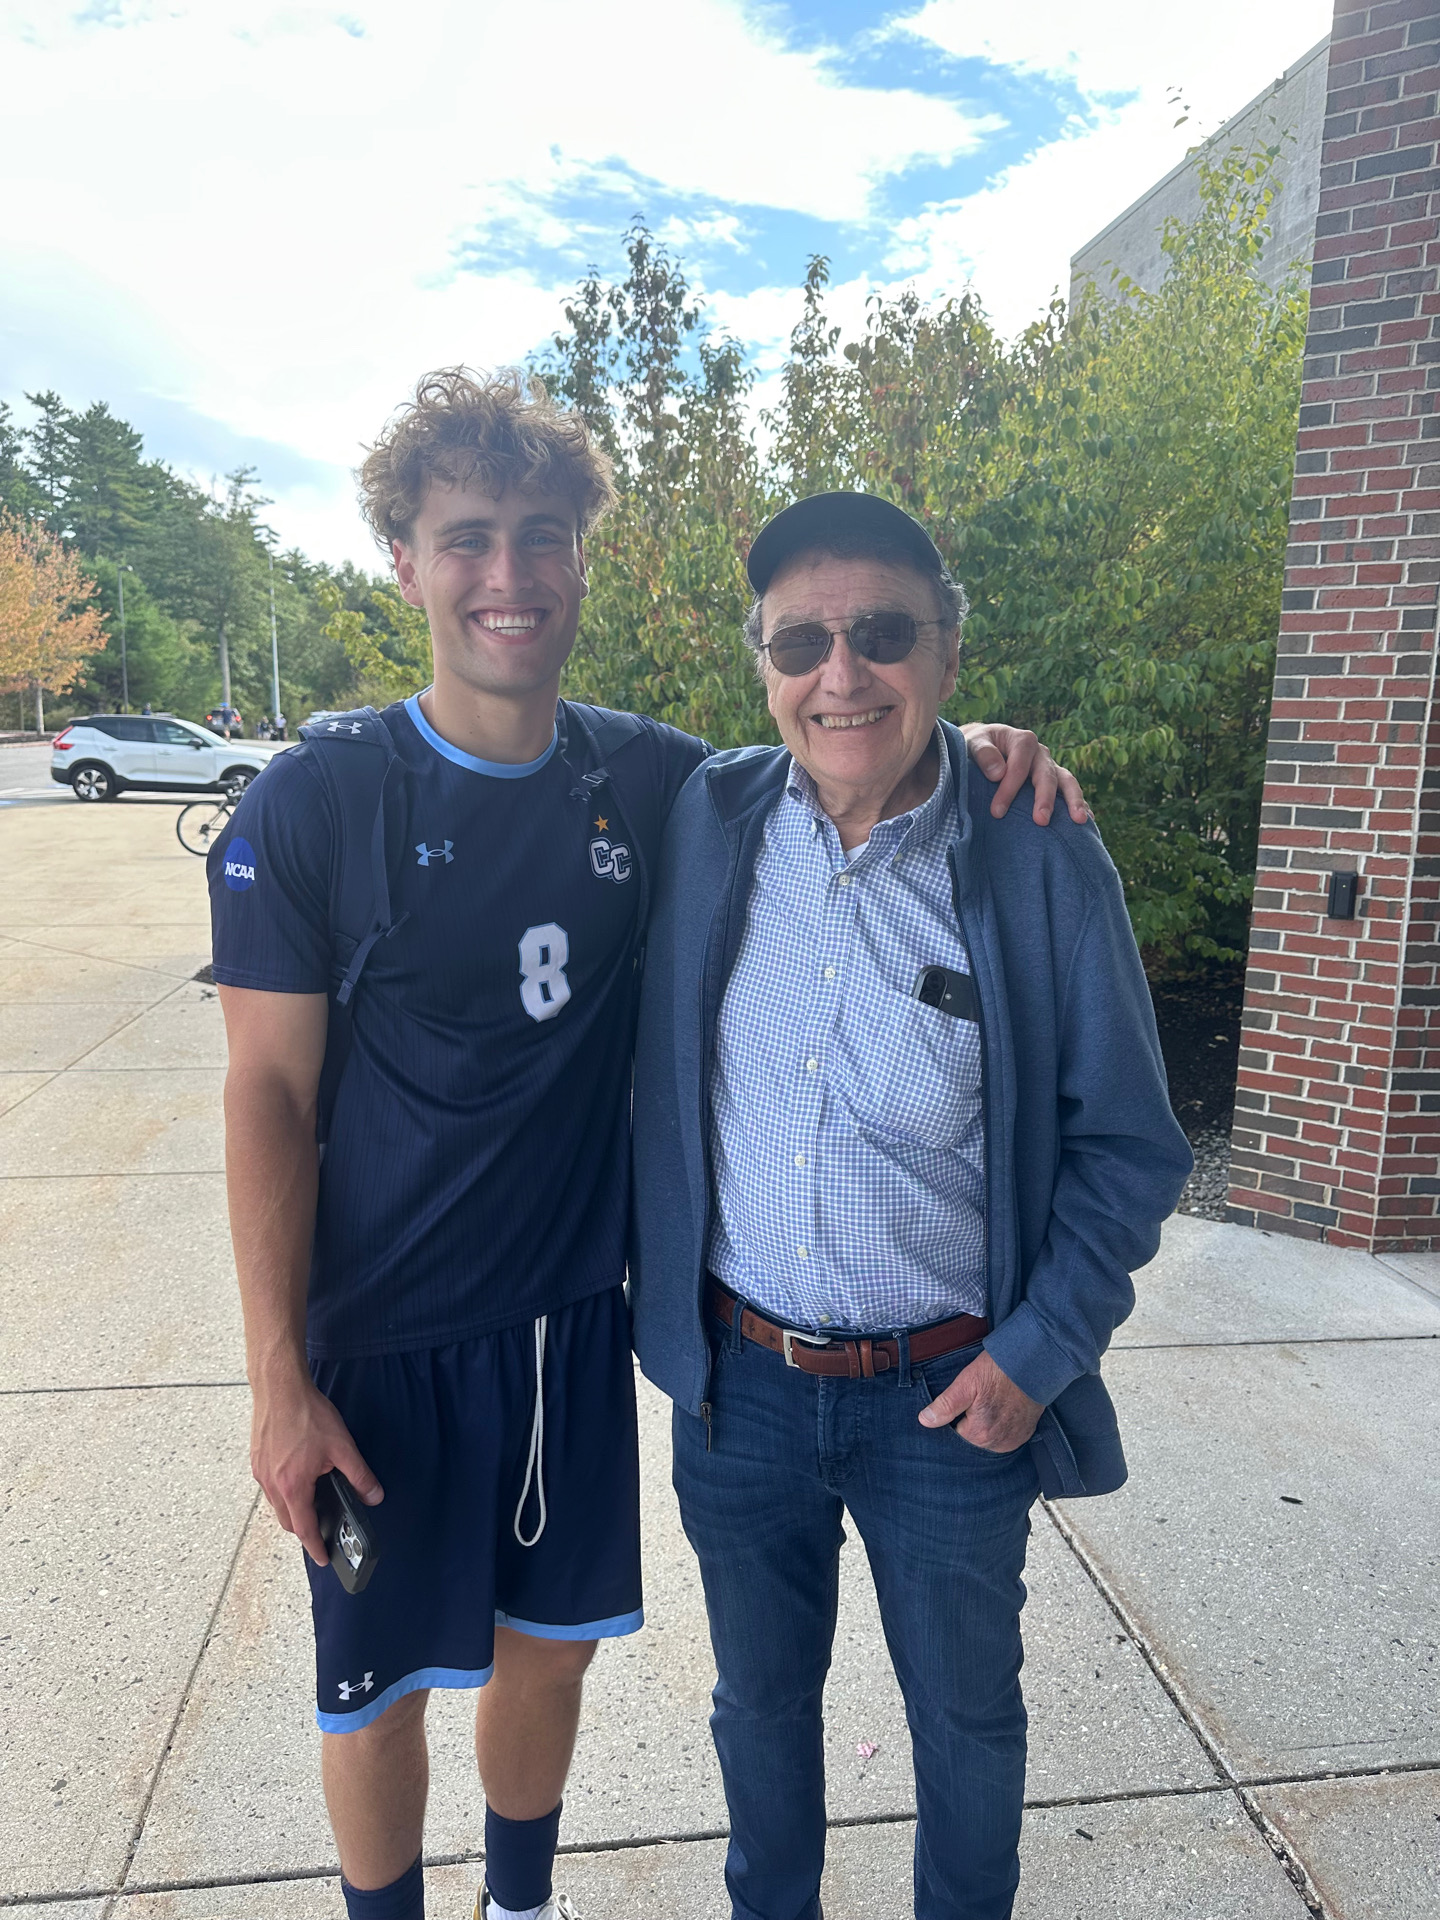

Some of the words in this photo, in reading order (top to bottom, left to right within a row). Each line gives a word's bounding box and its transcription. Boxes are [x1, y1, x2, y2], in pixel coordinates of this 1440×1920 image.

[225, 861, 256, 881] NCAA
[589, 837, 632, 884] CC
[518, 922, 571, 1023] 8
